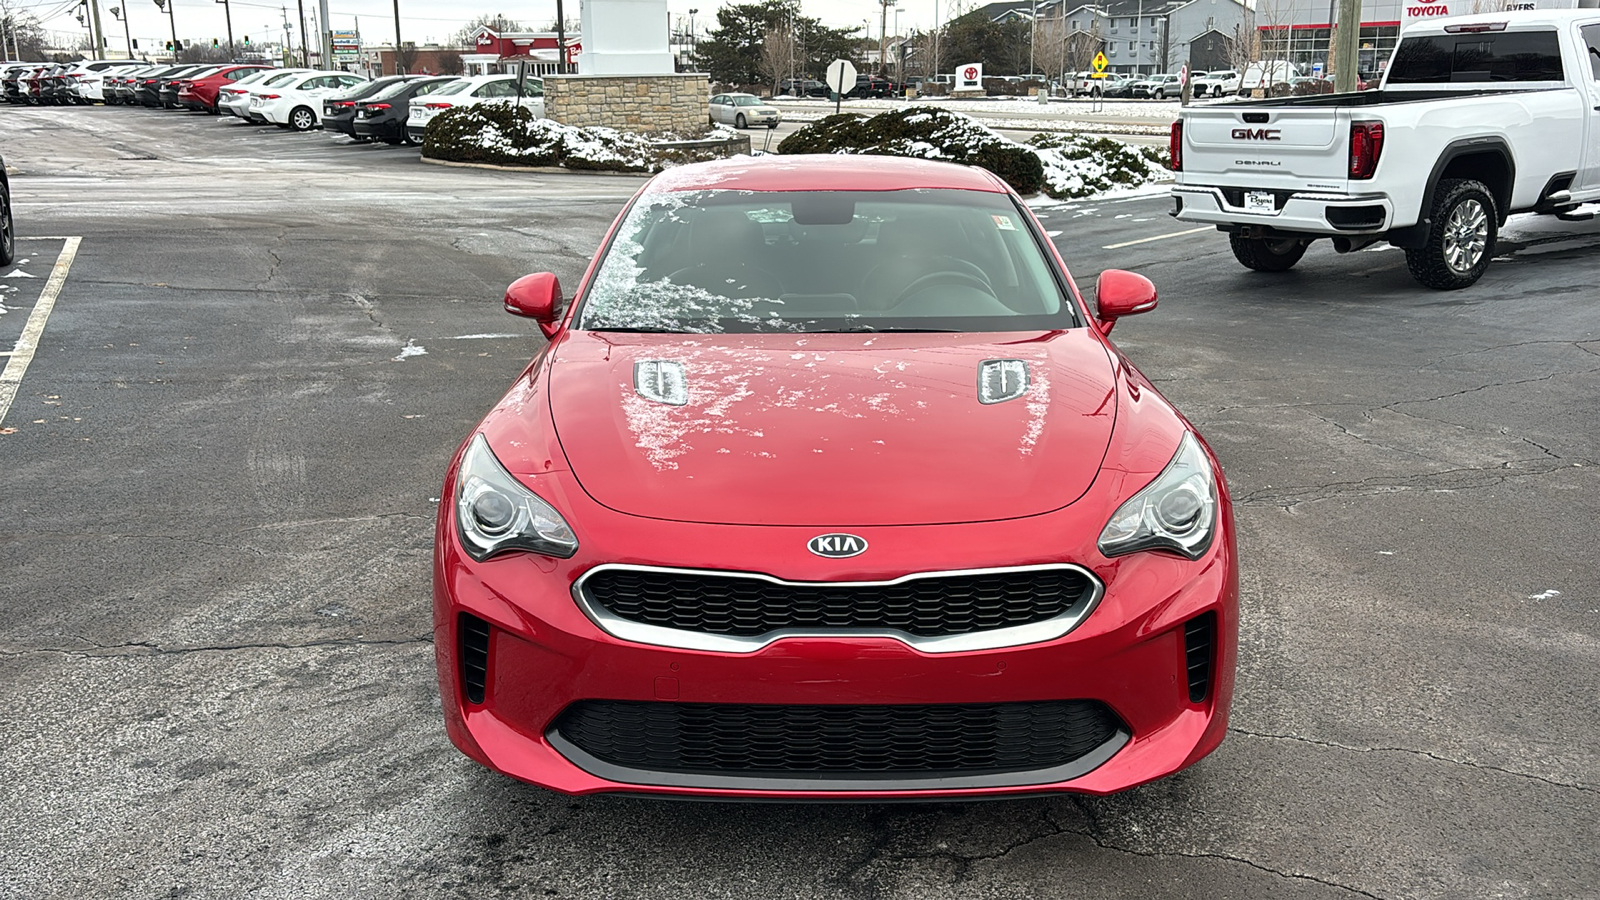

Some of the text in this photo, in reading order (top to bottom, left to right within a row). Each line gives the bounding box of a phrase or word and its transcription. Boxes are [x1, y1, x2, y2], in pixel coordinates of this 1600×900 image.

[1407, 5, 1449, 17] TOYOTA
[1231, 128, 1282, 141] GMC
[817, 537, 859, 552] KIA
